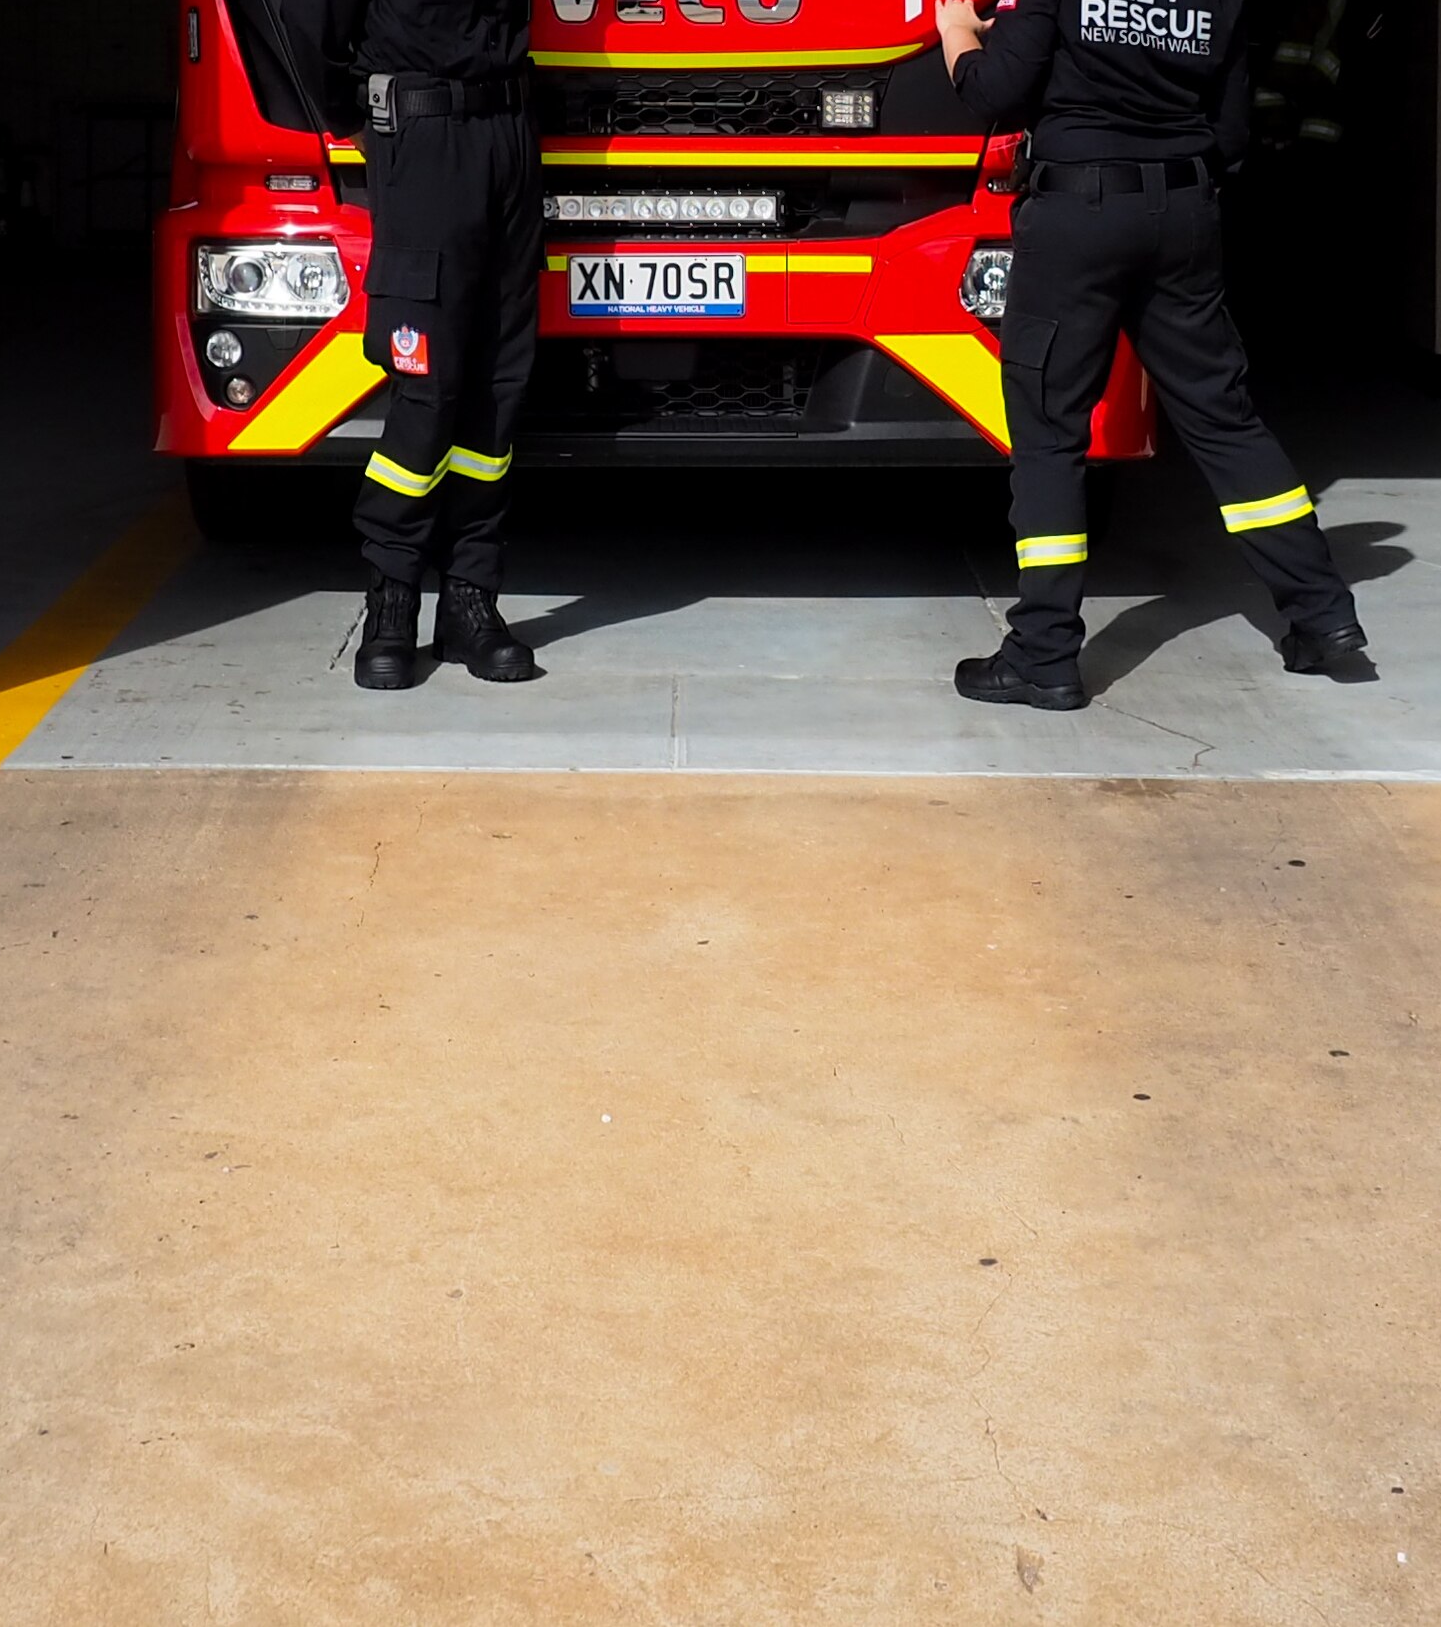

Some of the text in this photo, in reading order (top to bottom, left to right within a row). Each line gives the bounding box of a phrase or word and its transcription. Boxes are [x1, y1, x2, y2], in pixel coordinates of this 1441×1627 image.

[1081, 27, 1210, 56] NEW SOUTH WALES
[577, 262, 735, 300] XN 70SR
[607, 305, 706, 313] NATIONAL HEAVY VEHICLE
